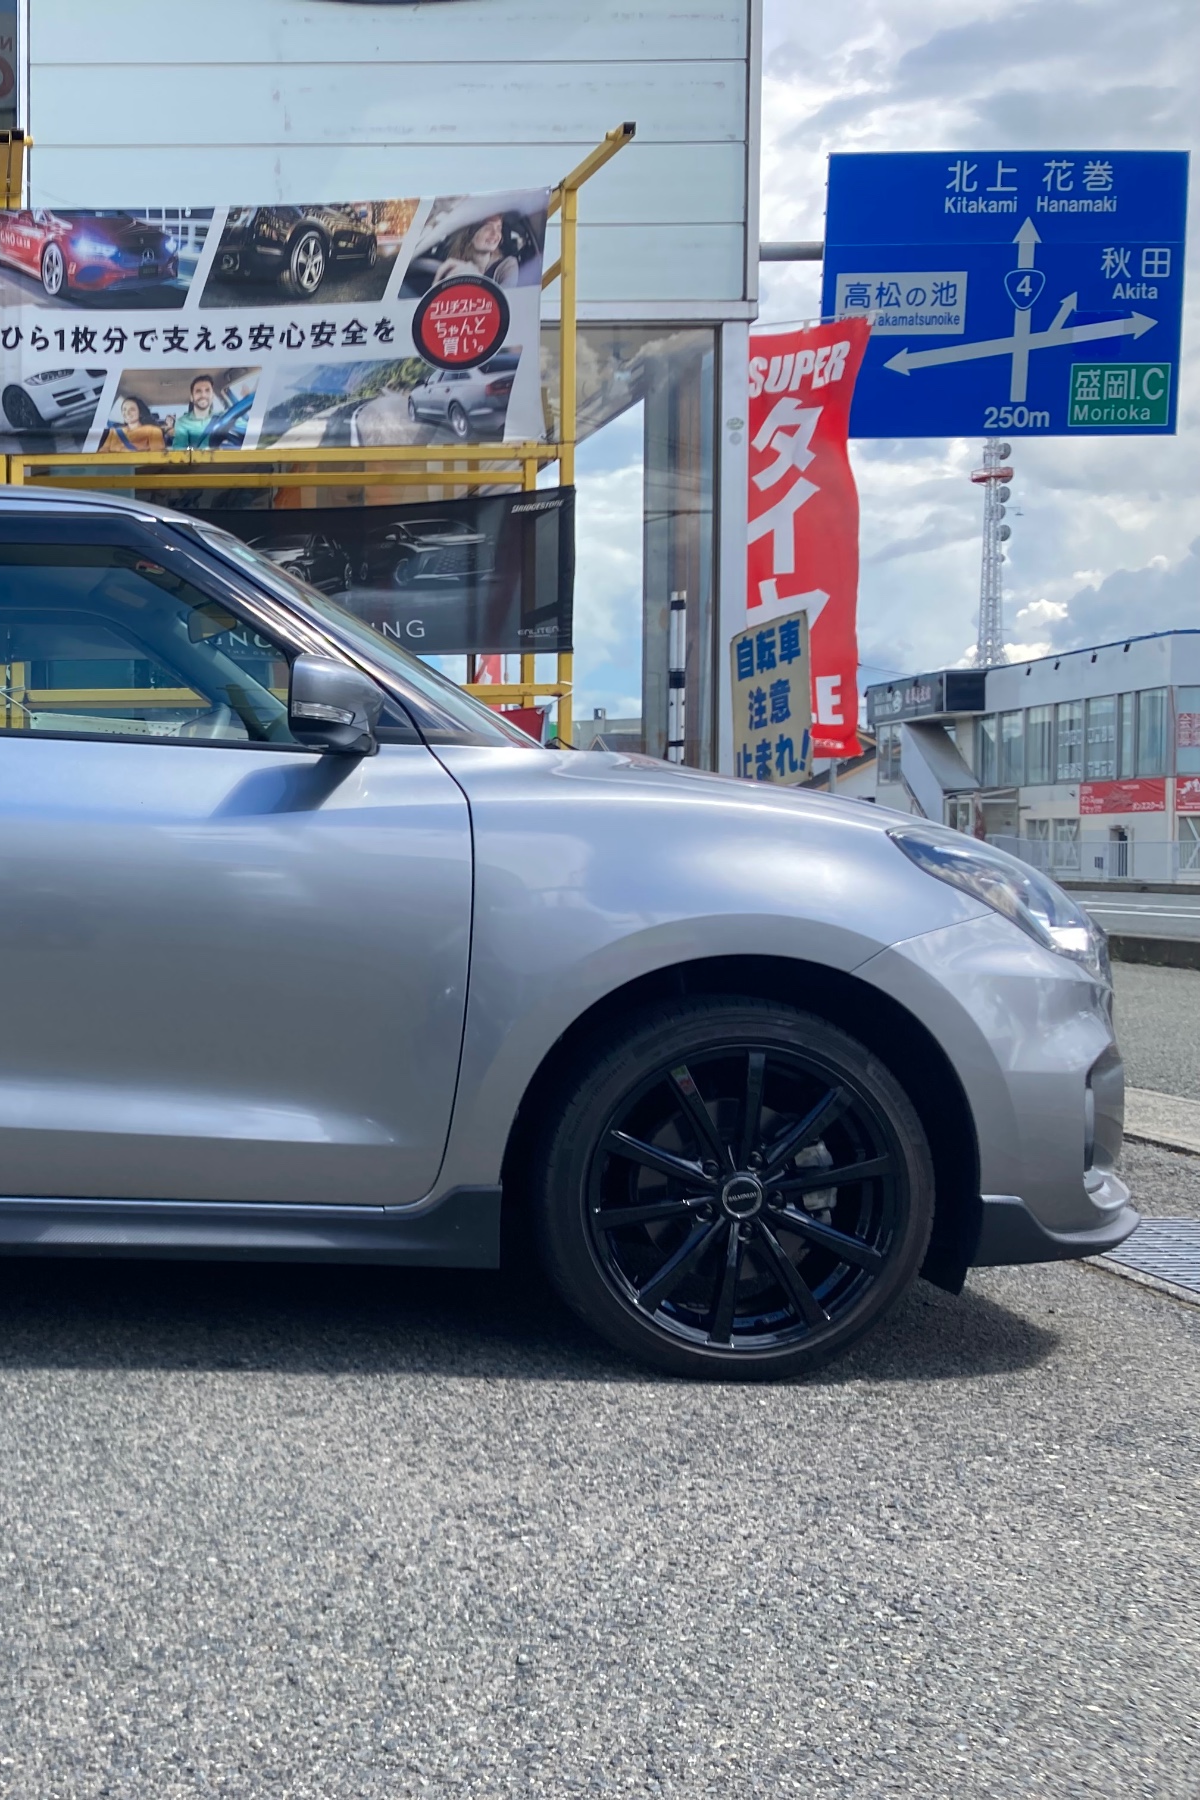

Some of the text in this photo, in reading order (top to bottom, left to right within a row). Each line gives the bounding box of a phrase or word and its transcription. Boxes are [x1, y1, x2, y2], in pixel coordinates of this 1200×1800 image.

[946, 160, 1114, 193] 北上 花巻
[944, 195, 1118, 214] Kitakami Hanamaki
[1101, 247, 1171, 279] 秋田
[844, 281, 958, 310] 高松の池
[1016, 275, 1032, 297] 4
[1112, 282, 1158, 300] Akita
[434, 315, 486, 338] ちゃんと
[443, 335, 484, 357] 買い。
[749, 340, 851, 399] SUPER
[983, 406, 1050, 429] 250m
[1073, 404, 1151, 421] Morioka
[736, 619, 802, 682] 自転車
[748, 678, 791, 731] 注意
